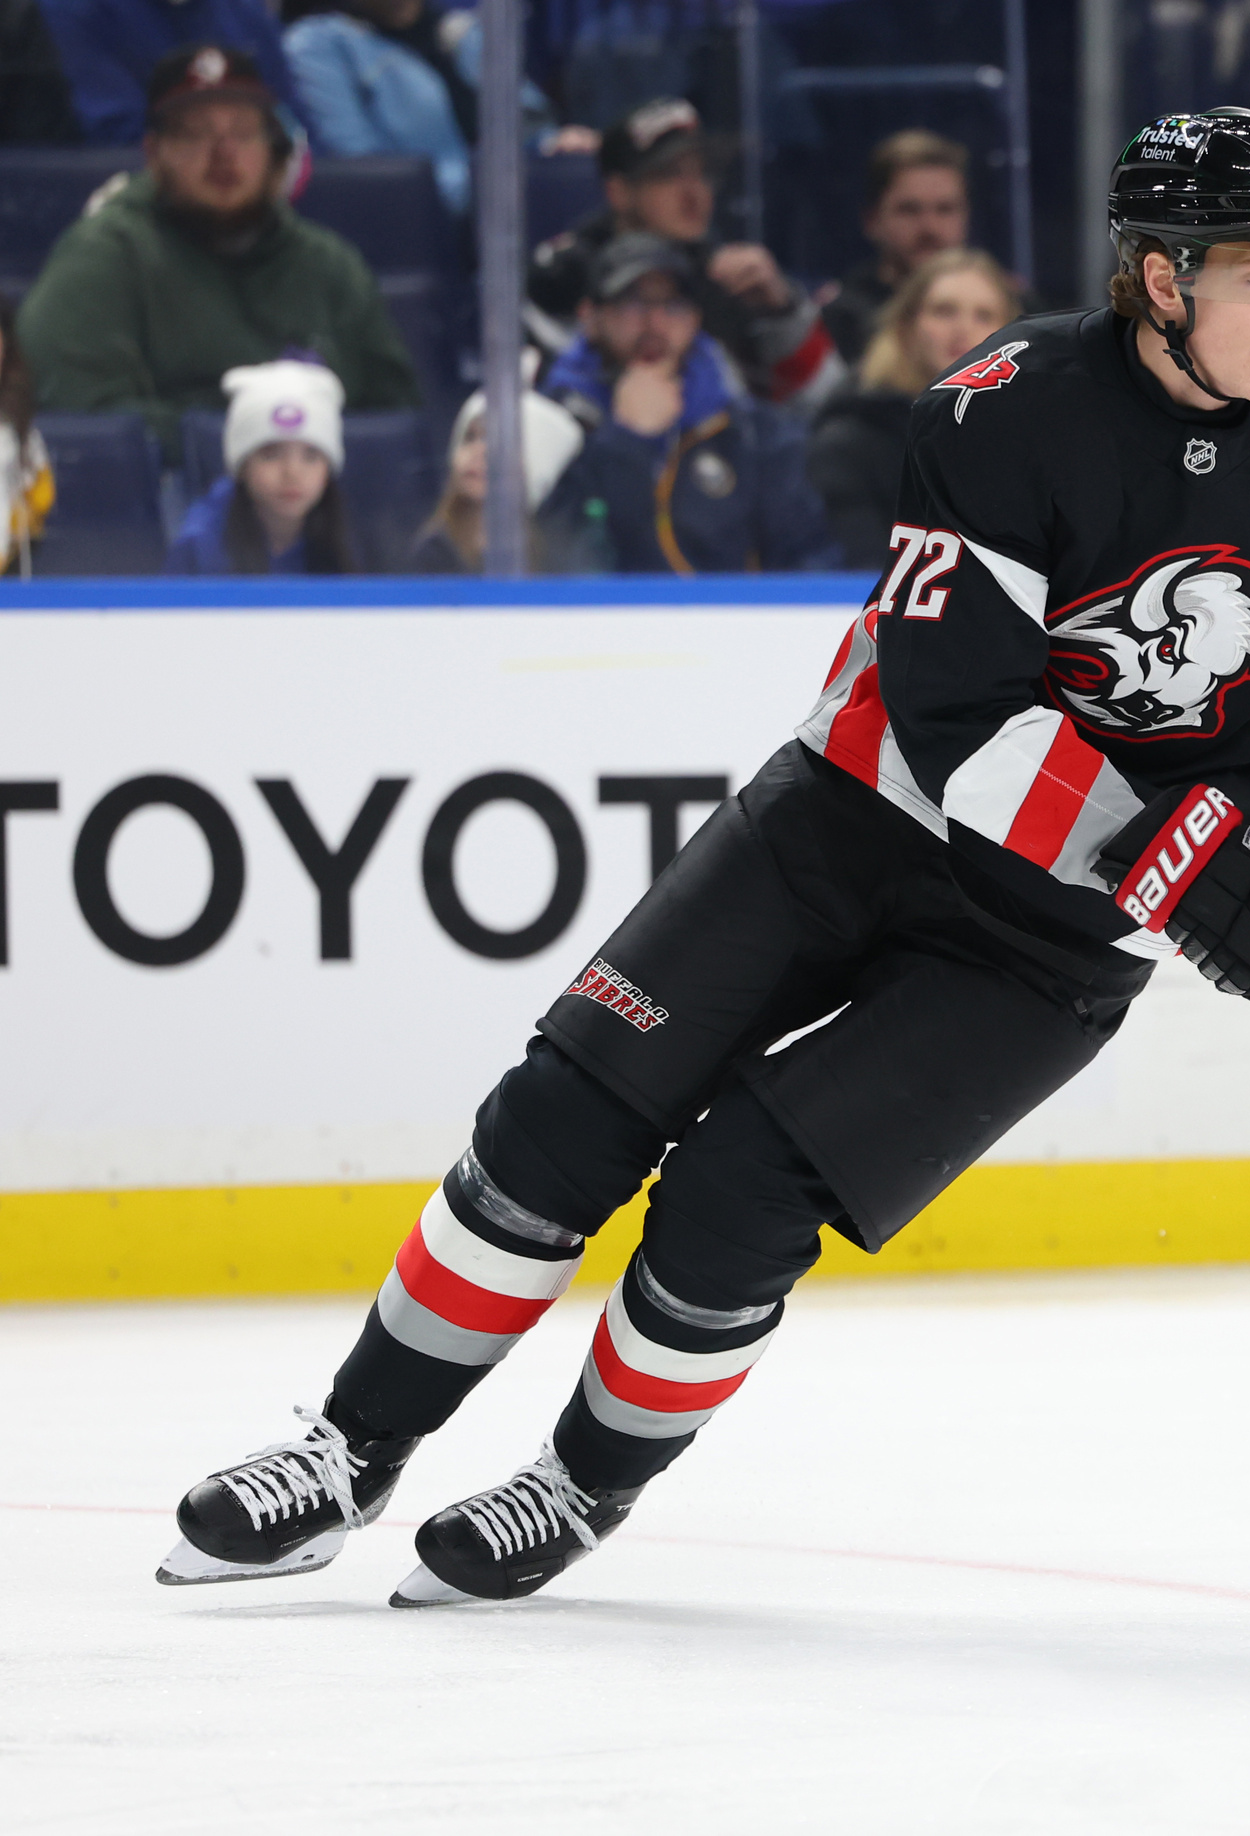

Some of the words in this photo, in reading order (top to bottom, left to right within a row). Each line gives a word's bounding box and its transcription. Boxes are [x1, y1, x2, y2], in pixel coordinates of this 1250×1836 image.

[1137, 126, 1204, 150] Trusted
[1140, 144, 1176, 162] talent
[1190, 450, 1210, 466] NHL
[878, 522, 964, 621] 72
[1122, 787, 1236, 926] BAUER
[562, 966, 665, 1033] SABRES
[592, 957, 670, 1021] BUFFALO
